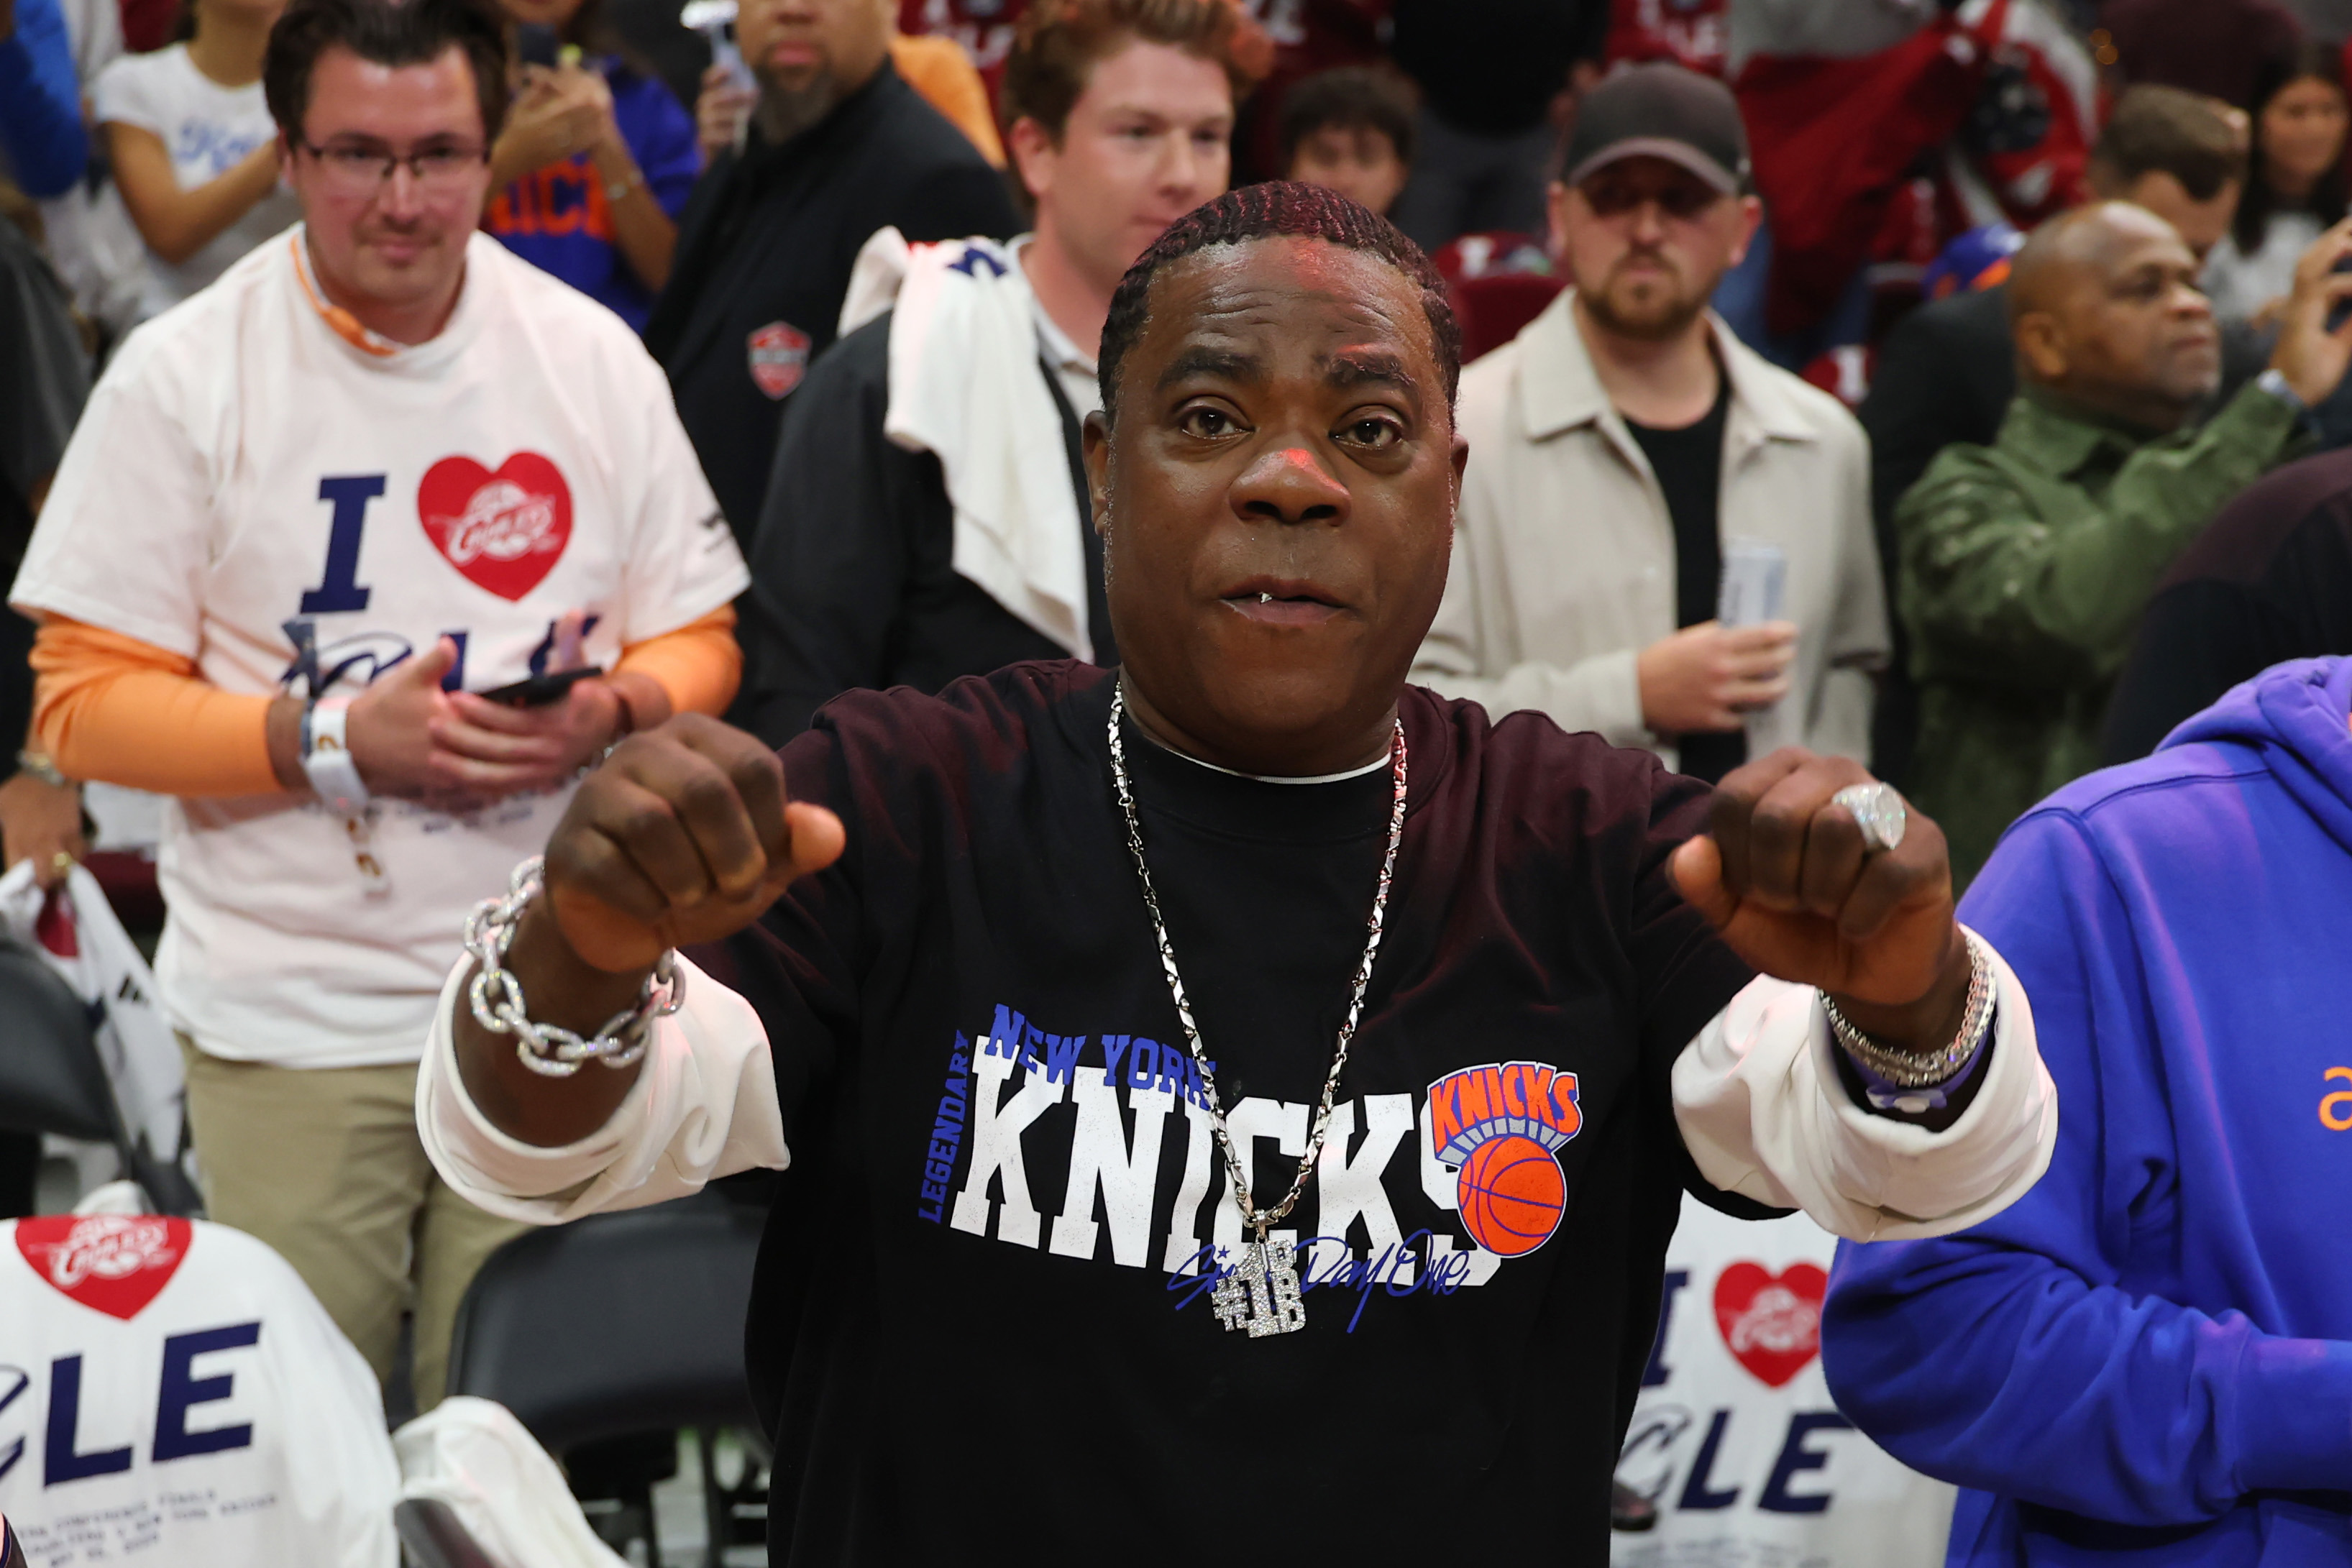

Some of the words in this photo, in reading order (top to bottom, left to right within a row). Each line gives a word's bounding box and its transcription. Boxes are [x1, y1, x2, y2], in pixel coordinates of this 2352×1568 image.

[301, 474, 386, 613] I
[985, 1003, 1086, 1086] NEW
[1101, 1034, 1217, 1111] YORK
[1428, 1063, 1580, 1155] KNICKS
[918, 1030, 969, 1224] LEGENDARY
[1292, 1236, 1394, 1333] Day
[1386, 1228, 1470, 1297] One
